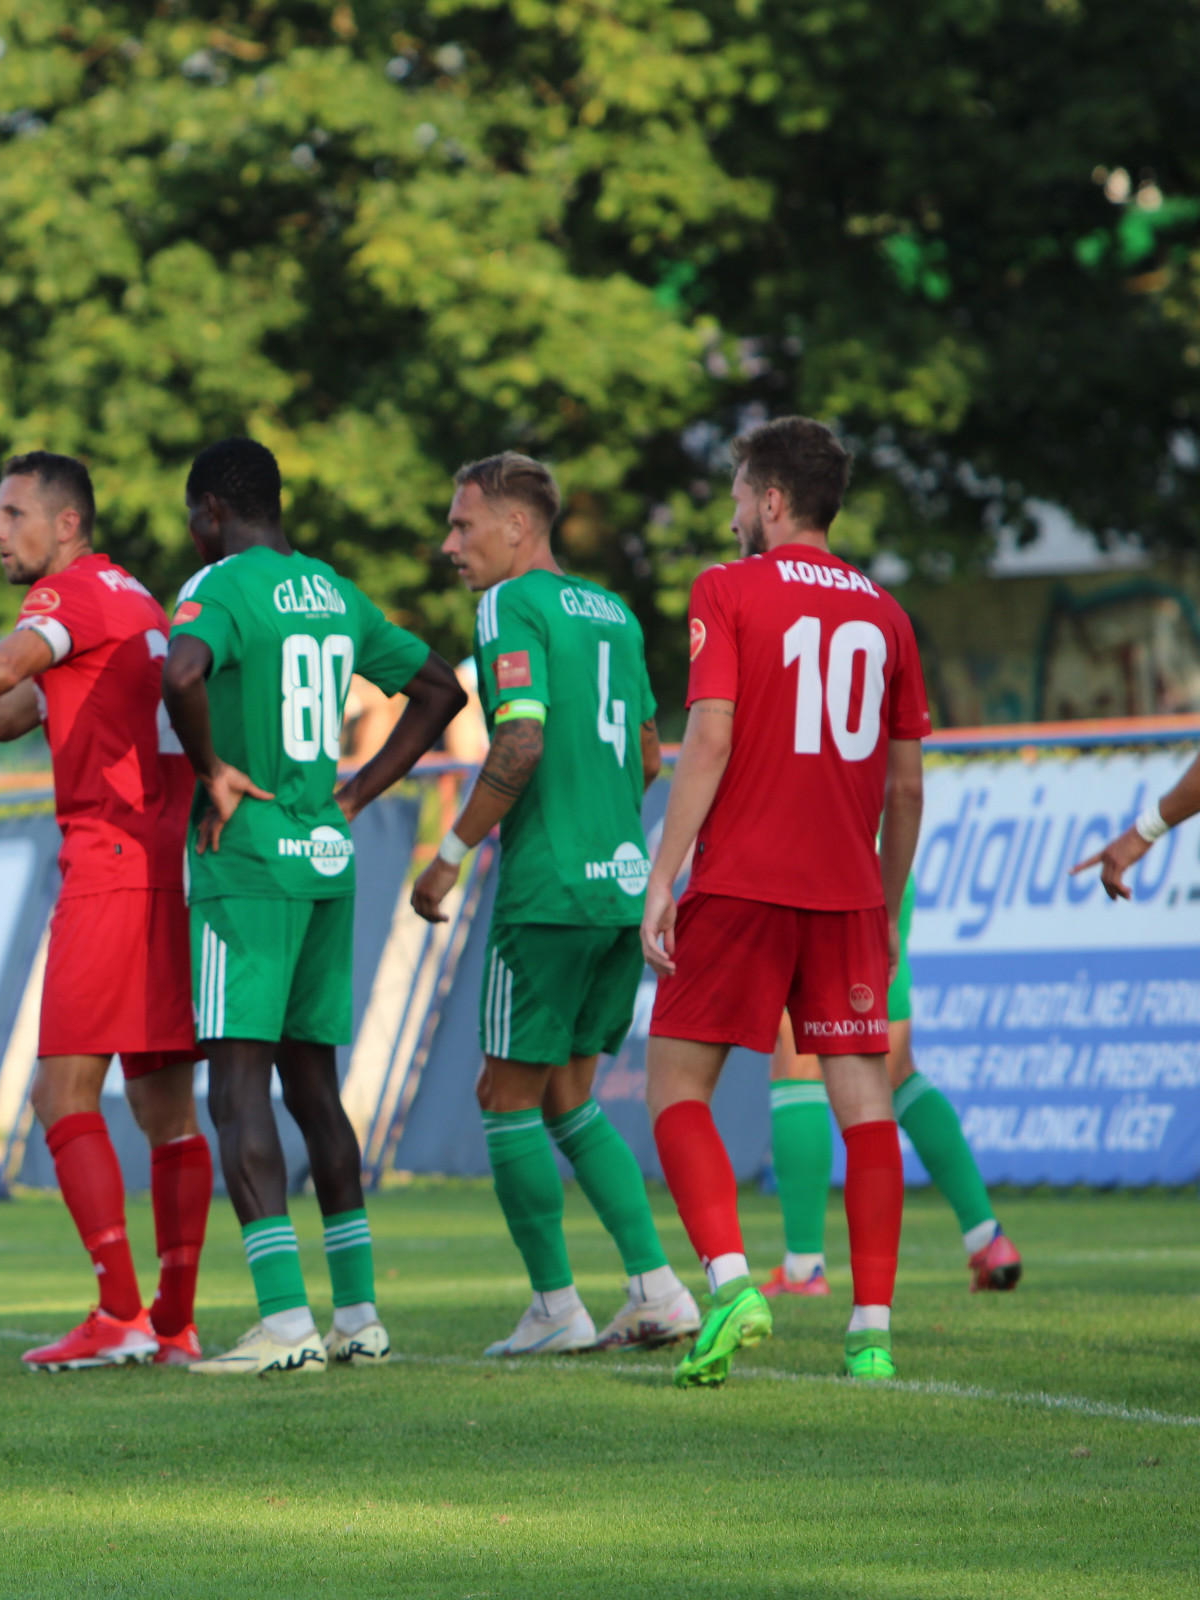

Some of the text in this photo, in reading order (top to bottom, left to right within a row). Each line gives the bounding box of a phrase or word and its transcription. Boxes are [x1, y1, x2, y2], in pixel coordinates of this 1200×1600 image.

[776, 559, 880, 599] KOUSAL
[281, 633, 355, 763] 80
[597, 640, 626, 769] 4
[783, 614, 888, 763] 10
[804, 1020, 866, 1036] PECADO
